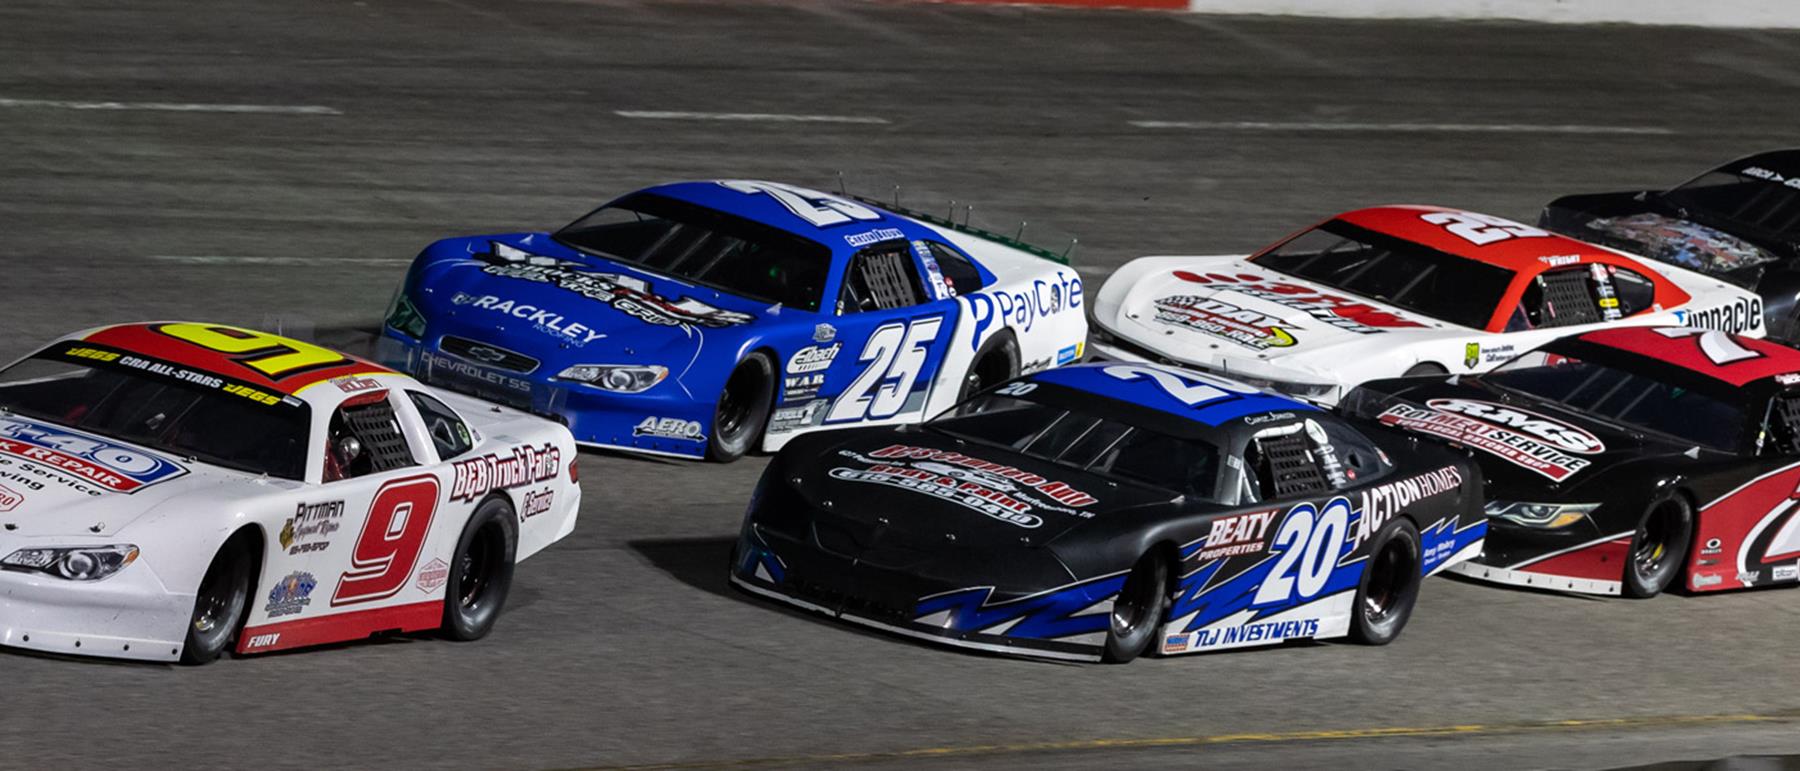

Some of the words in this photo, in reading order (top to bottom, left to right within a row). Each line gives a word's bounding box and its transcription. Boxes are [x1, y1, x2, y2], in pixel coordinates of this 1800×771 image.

[472, 295, 608, 343] RACKLEY
[66, 348, 120, 362] JEGS
[119, 356, 150, 371] CRA
[149, 363, 223, 388] ALL-STARS
[223, 383, 281, 405] JEGS
[421, 352, 508, 386] CHEVROLET
[507, 376, 532, 393] SS
[825, 315, 944, 424] 25
[995, 382, 1039, 396] 20
[639, 416, 702, 437] AERO
[1391, 405, 1433, 421] ROY
[1430, 412, 1494, 437] MEAT
[1489, 430, 1588, 470] SERVICE
[1434, 399, 1597, 450] RMS
[19, 463, 101, 496] Service
[23, 447, 122, 487] REPAIR
[484, 453, 527, 490] Truck
[523, 443, 560, 483] Parts
[868, 464, 939, 482] Body
[933, 476, 957, 489] &
[957, 482, 1032, 514] Paint
[1352, 480, 1422, 552] ACTION
[1415, 465, 1462, 498] HOMES
[294, 500, 345, 523] PITTMAN
[1204, 511, 1278, 548] BEATY
[332, 474, 441, 607] 9
[1197, 541, 1265, 561] PROPERTIES
[1253, 497, 1352, 605] 20
[248, 632, 280, 648] FURY
[1222, 618, 1320, 644] INVESTMENTS
